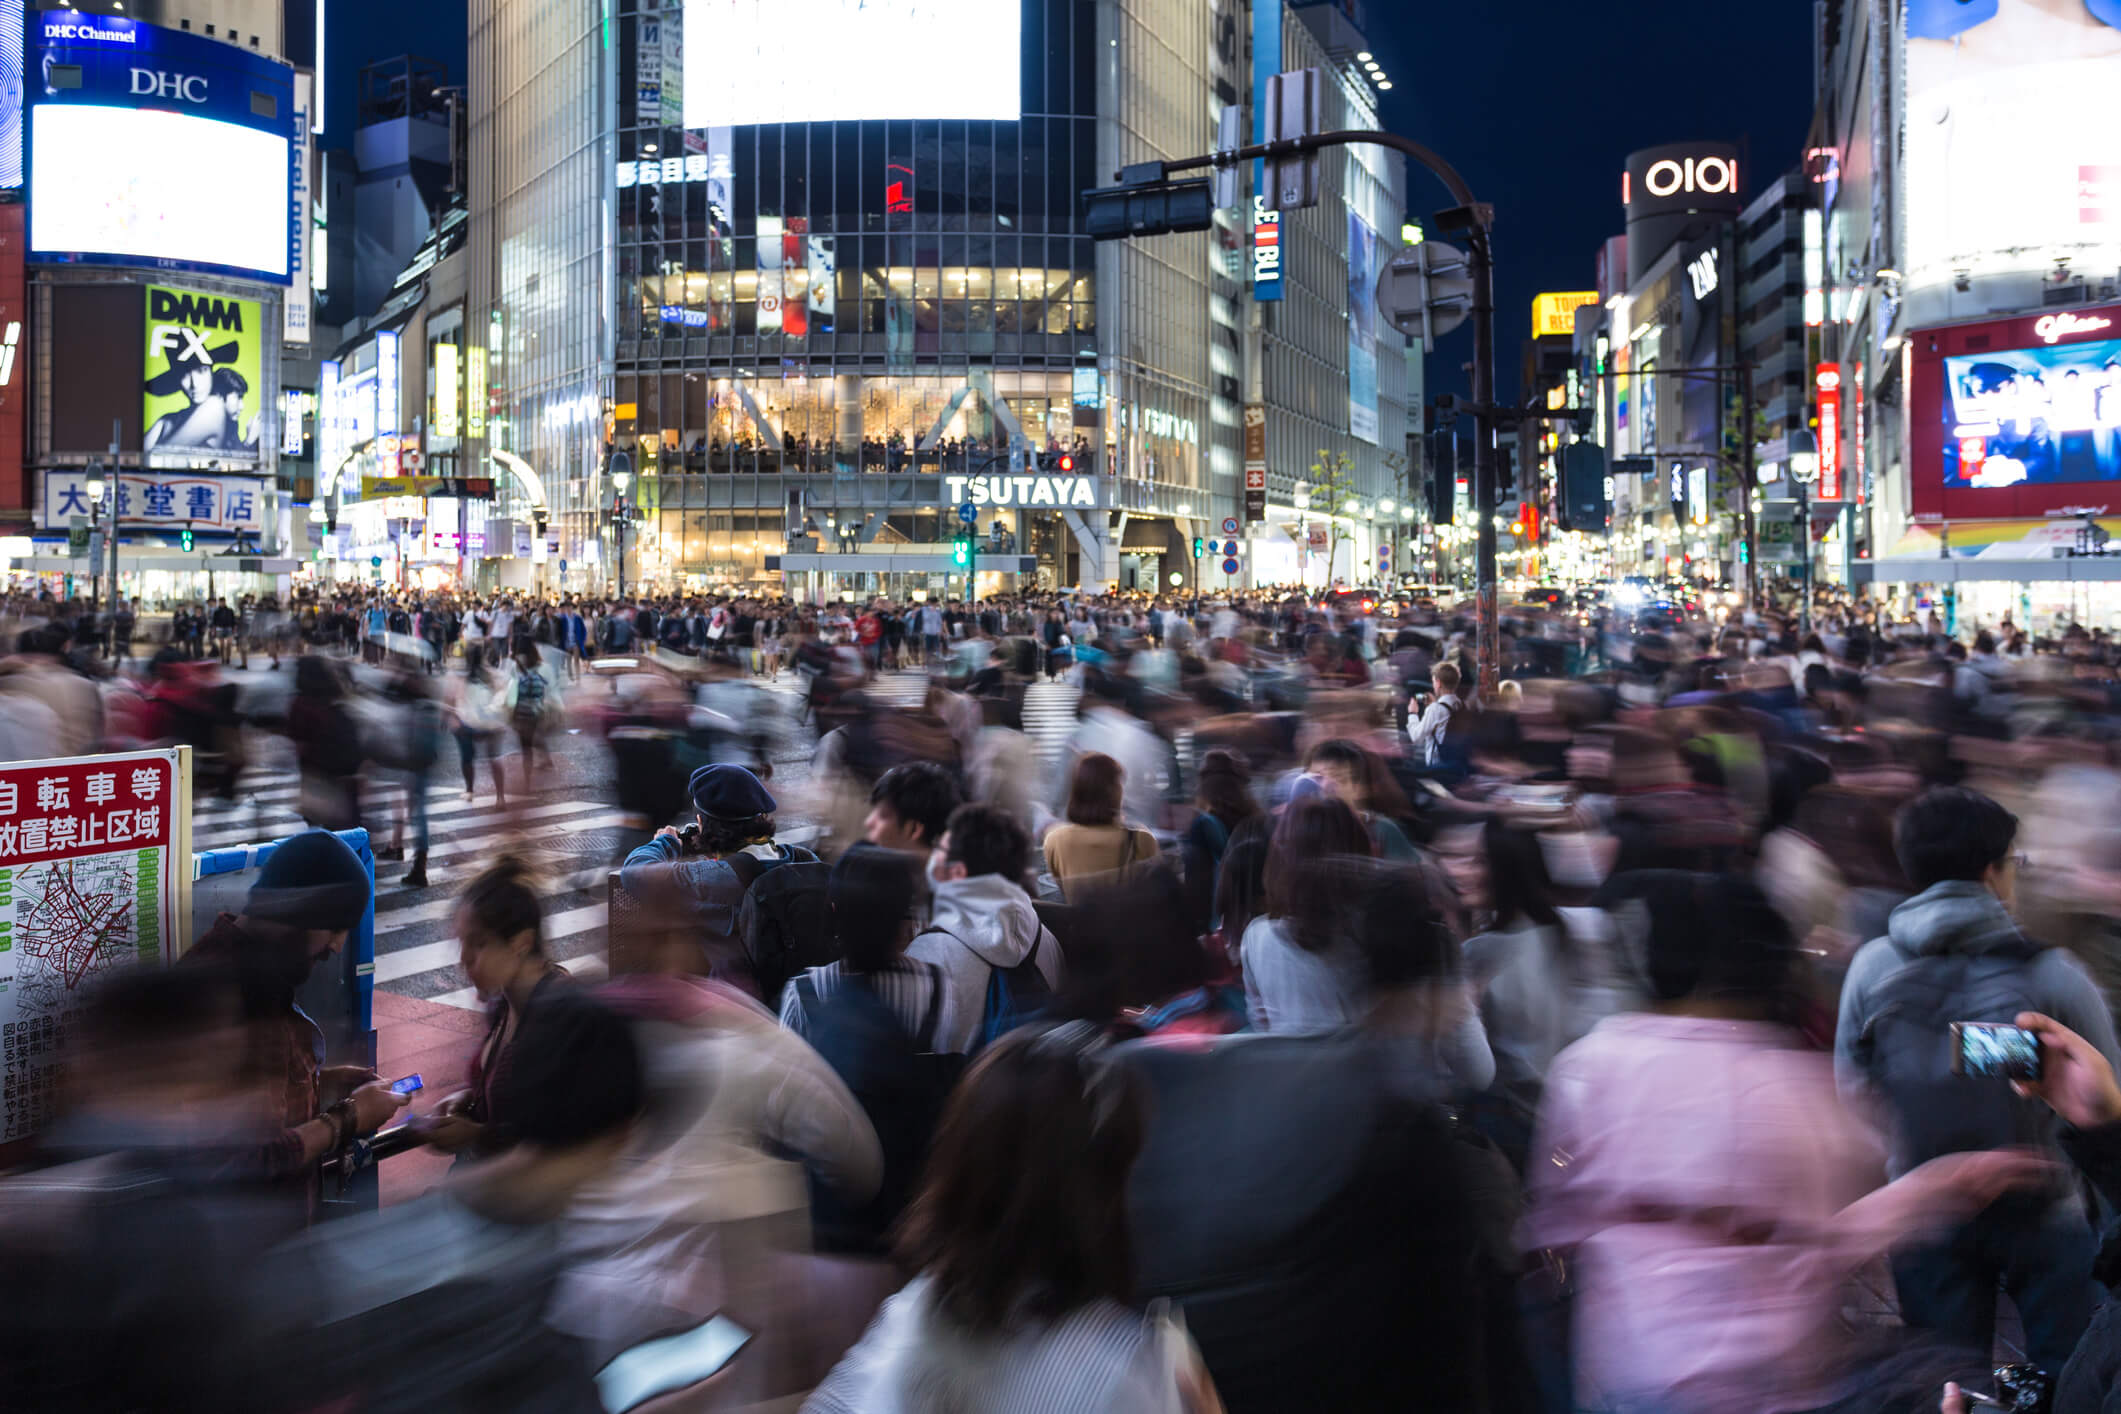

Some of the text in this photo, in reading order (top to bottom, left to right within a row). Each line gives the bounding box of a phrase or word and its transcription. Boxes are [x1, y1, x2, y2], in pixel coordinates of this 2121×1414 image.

[44, 24, 136, 43] DHC Channel
[129, 67, 208, 103] DHC
[150, 288, 243, 332] DMM
[150, 324, 213, 365] FX
[945, 476, 1095, 505] TSUTAYA
